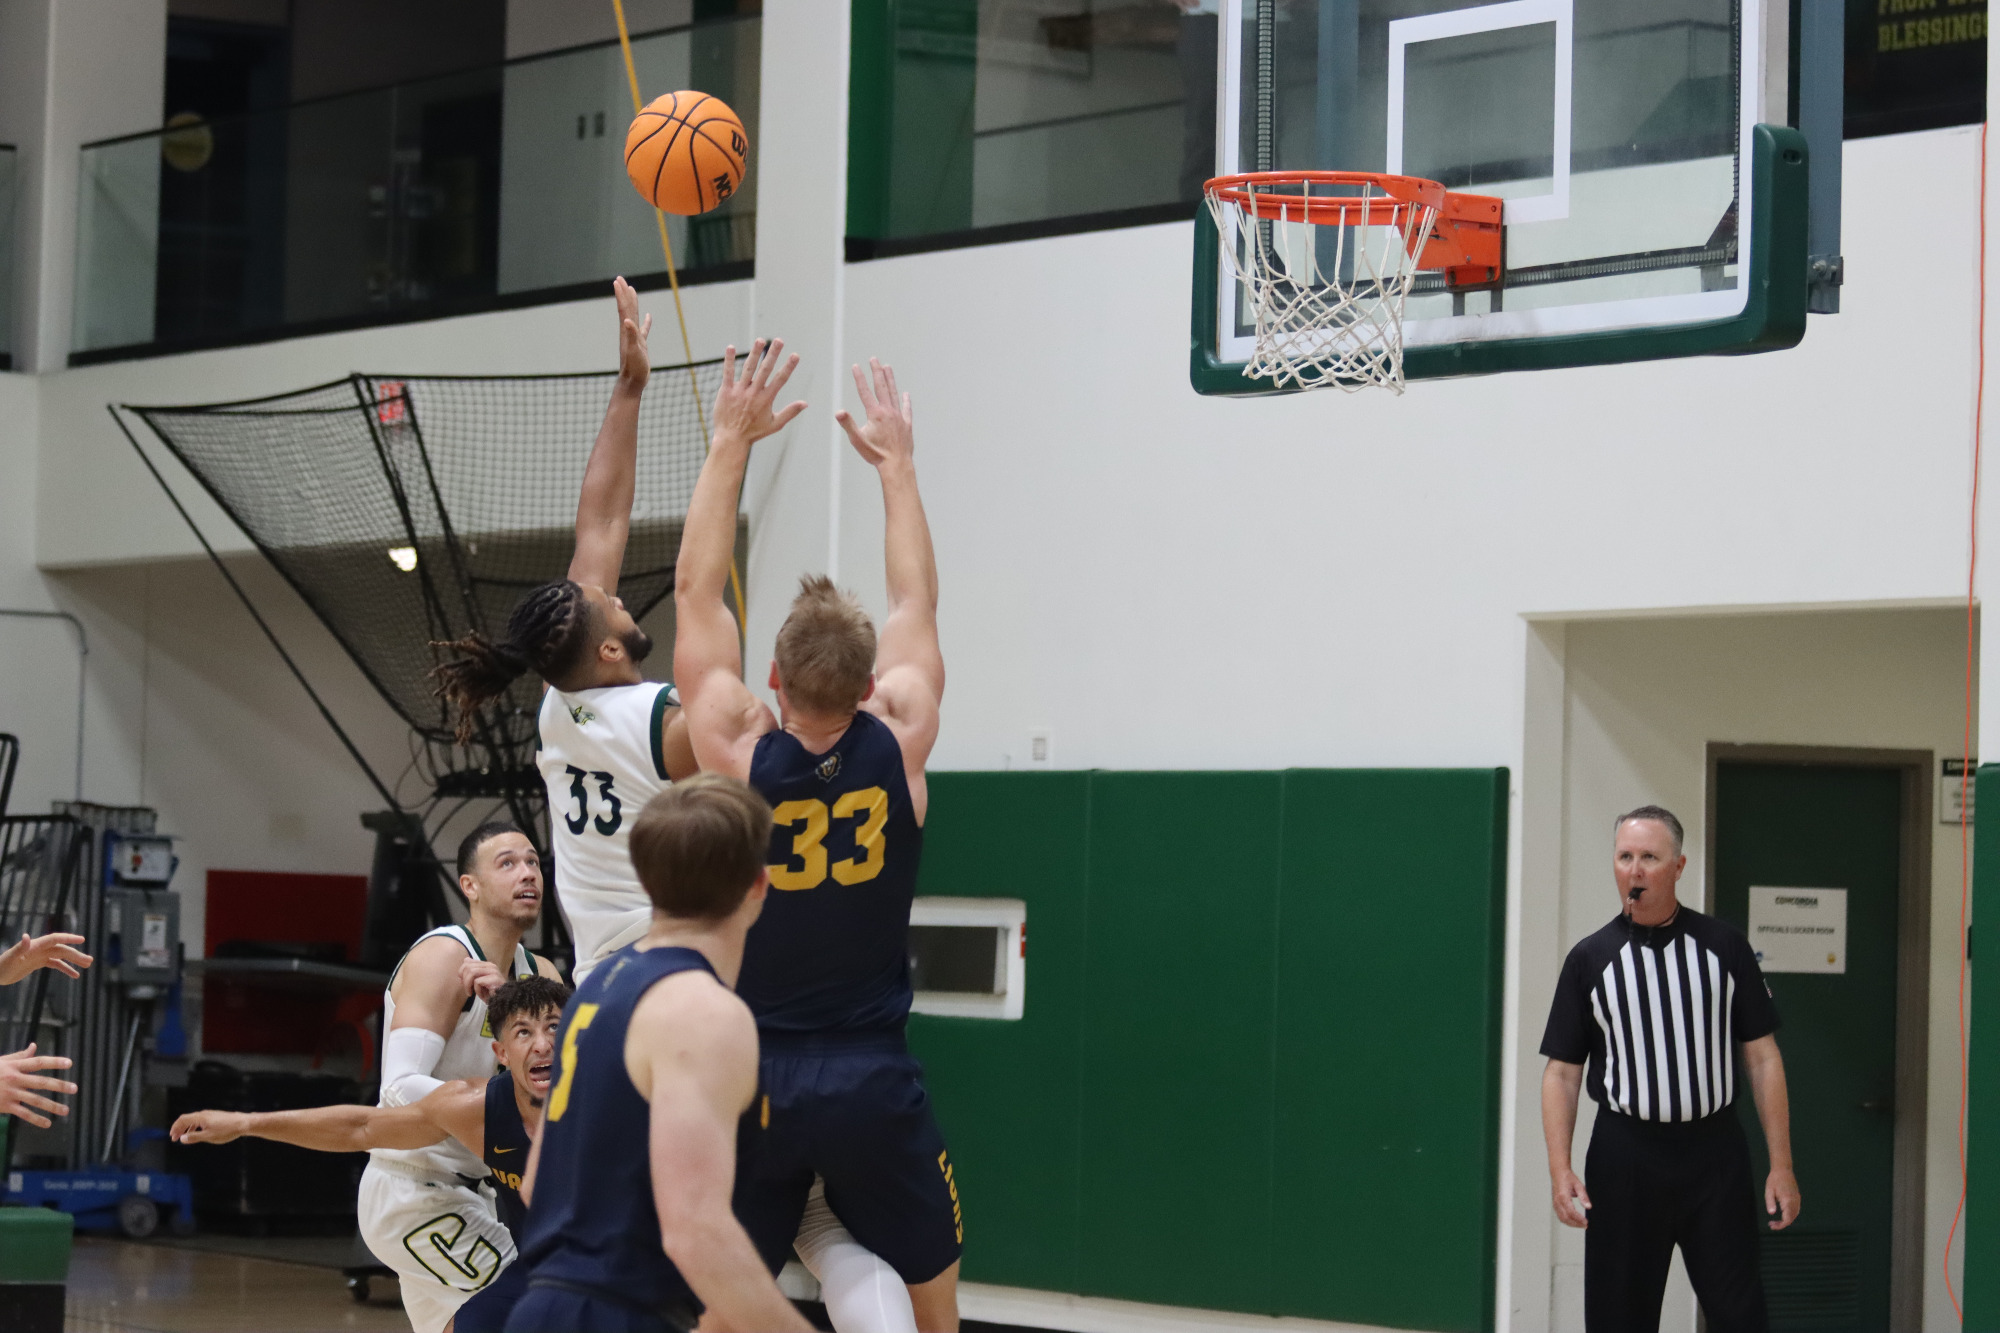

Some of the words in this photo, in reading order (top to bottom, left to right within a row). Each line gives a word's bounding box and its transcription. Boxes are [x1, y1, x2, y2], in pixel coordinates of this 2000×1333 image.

[713, 172, 733, 204] NC
[565, 763, 622, 836] 33
[766, 785, 888, 891] 33
[1757, 925, 1789, 934] OFFICIALS
[1790, 926, 1815, 934] LOCKER
[1816, 926, 1835, 935] ROOM
